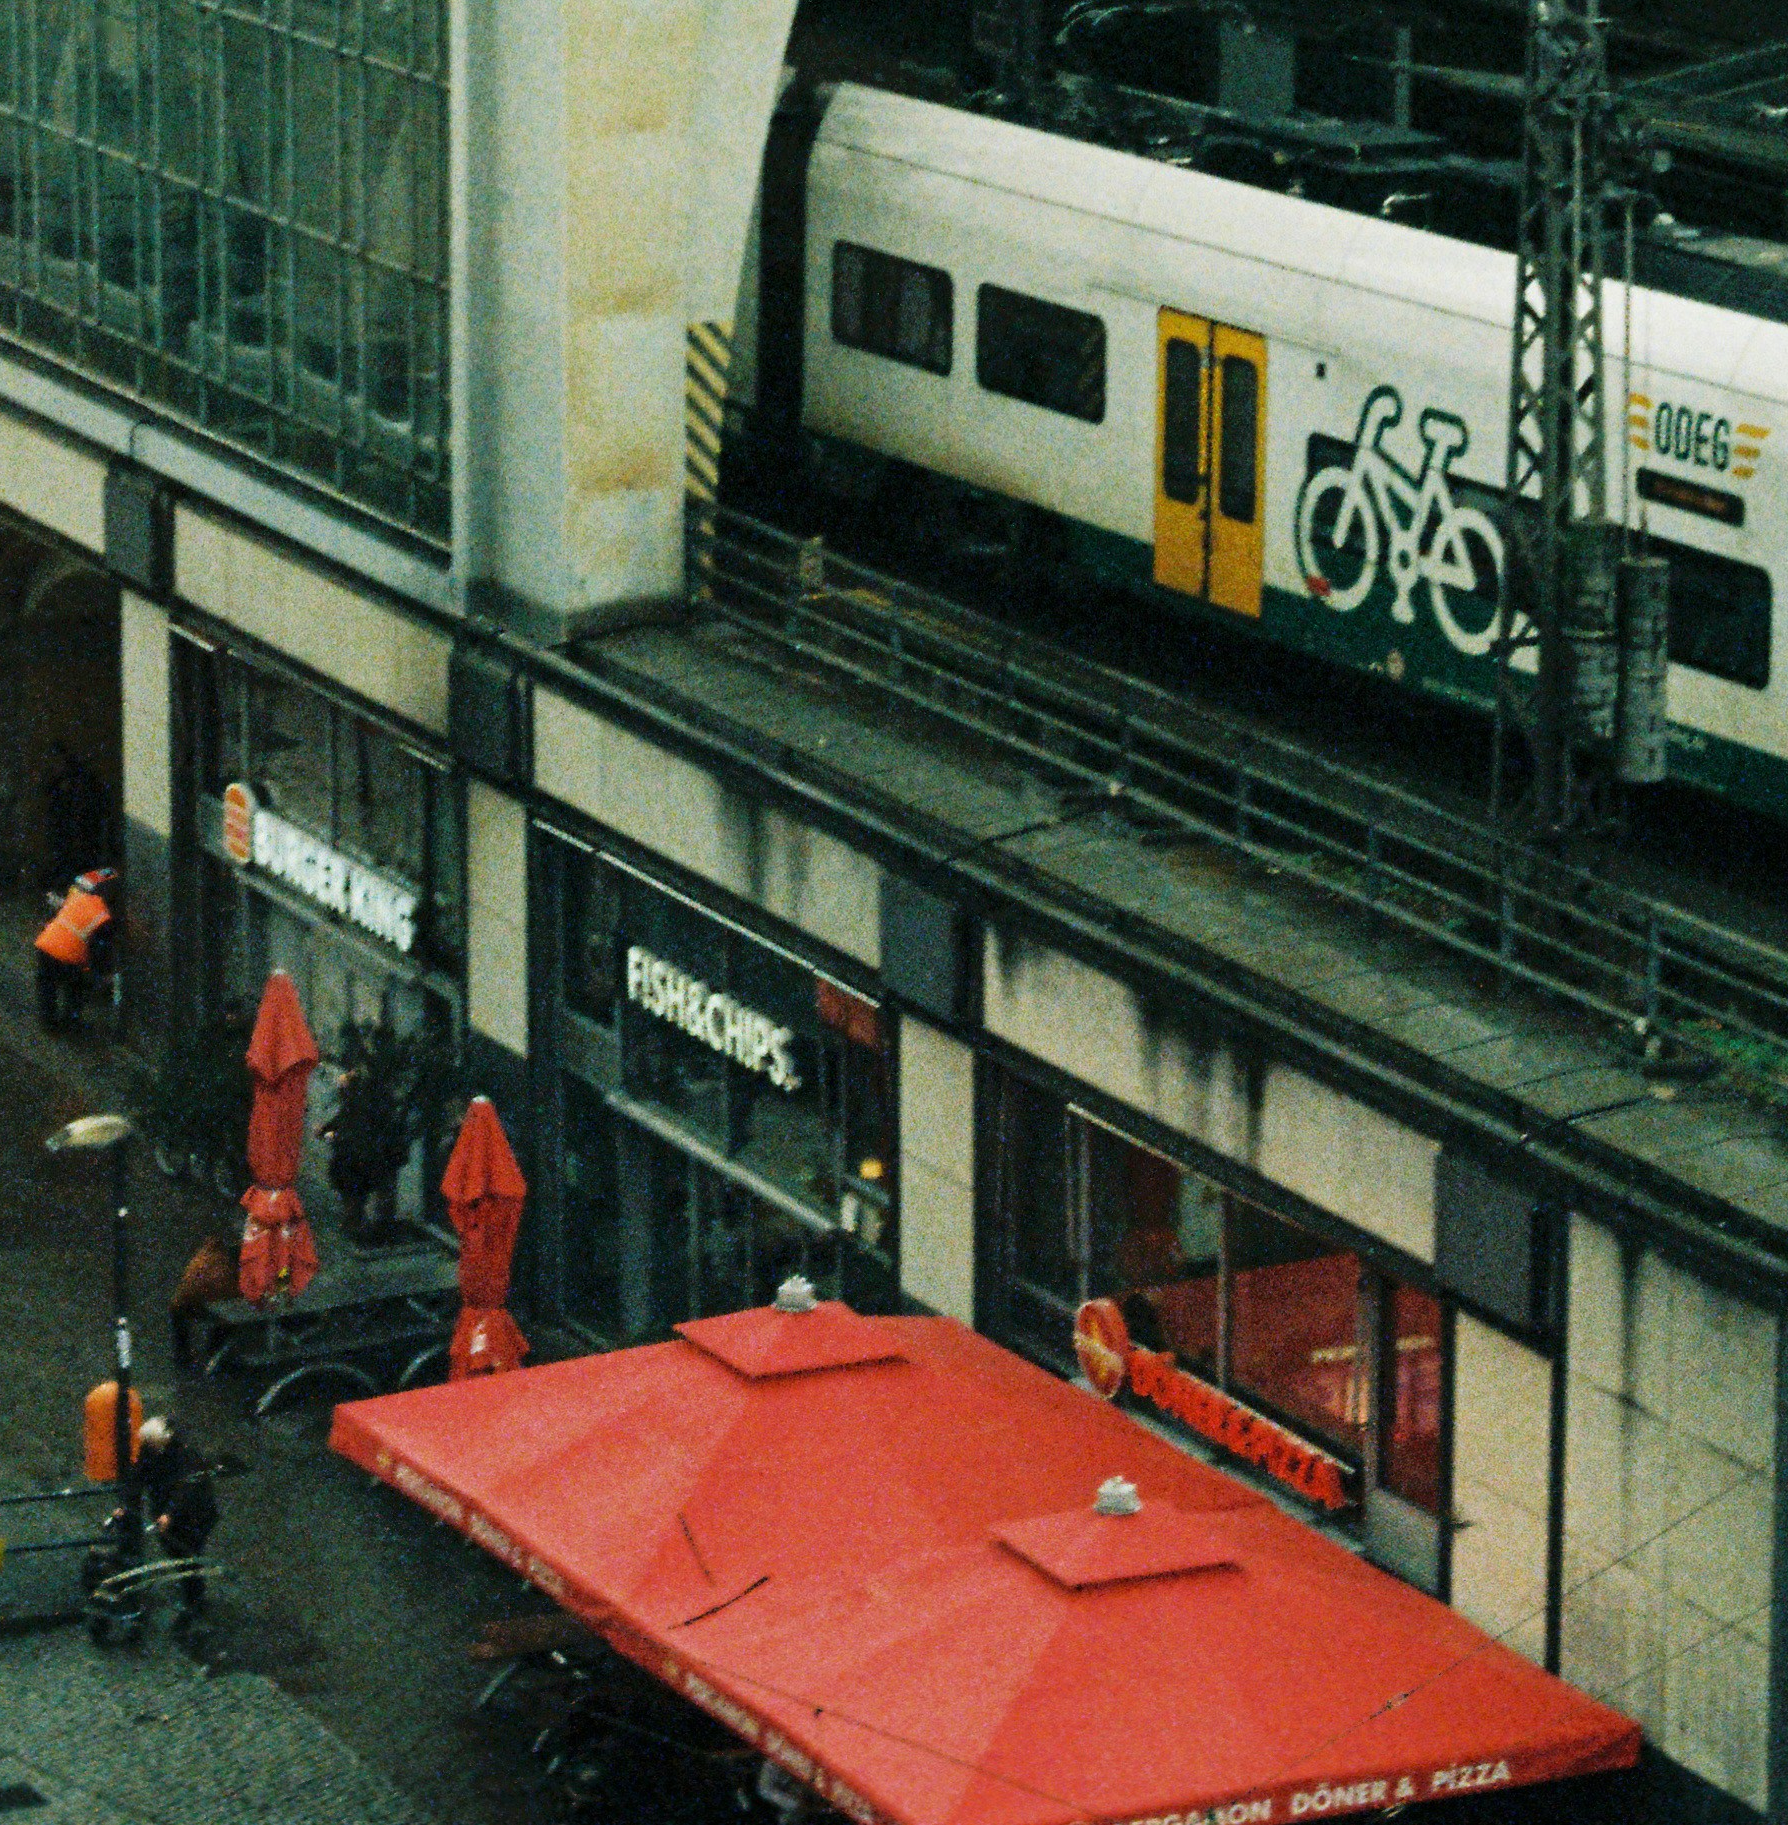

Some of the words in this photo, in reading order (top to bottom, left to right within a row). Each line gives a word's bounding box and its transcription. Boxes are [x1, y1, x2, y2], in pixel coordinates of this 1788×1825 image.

[1654, 401, 1731, 472] ODEG
[1290, 1780, 1388, 1816] DÖNER
[1395, 1776, 1414, 1798] &
